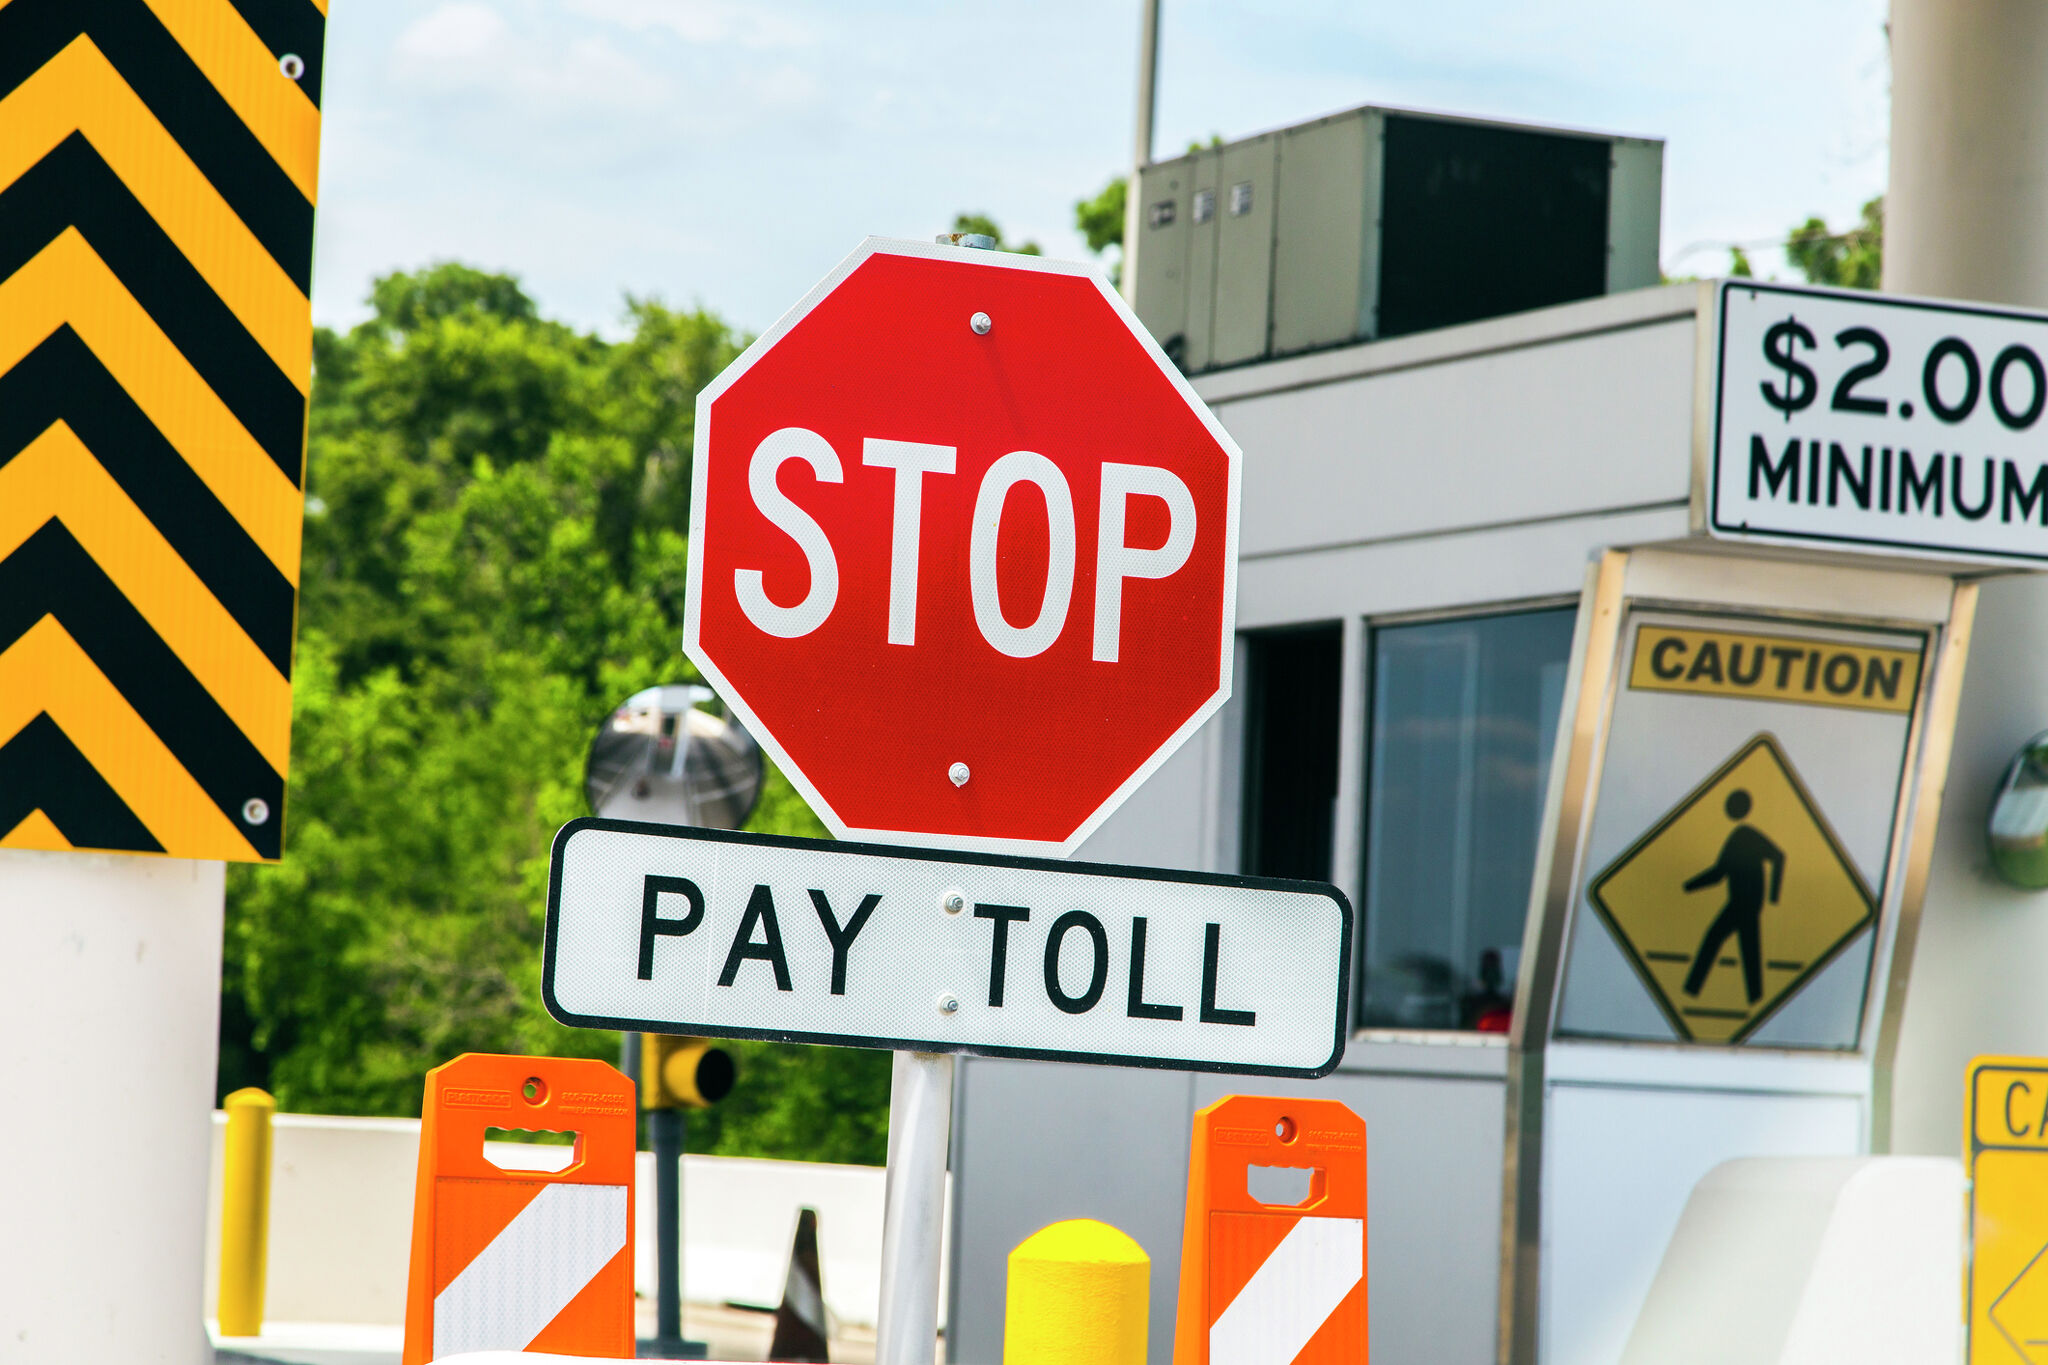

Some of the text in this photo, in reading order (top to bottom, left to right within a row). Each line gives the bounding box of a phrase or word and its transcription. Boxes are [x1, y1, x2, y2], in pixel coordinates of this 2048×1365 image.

[1760, 314, 2048, 432] $2.00
[1748, 433, 2048, 527] MINIMUM
[734, 427, 1198, 662] STOP
[1651, 637, 1904, 700] CAUTION
[637, 874, 1256, 1026] PAY TOLL
